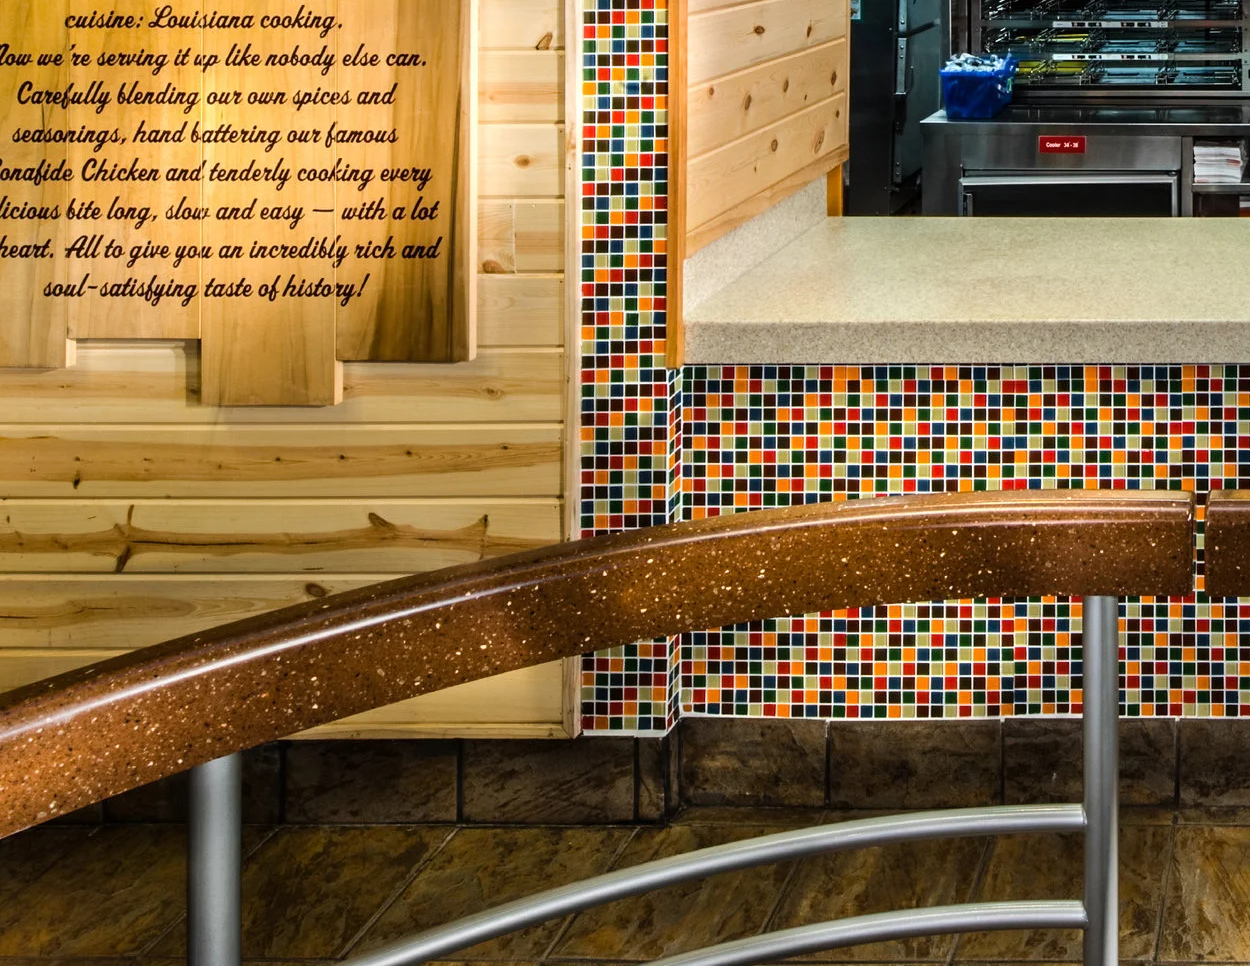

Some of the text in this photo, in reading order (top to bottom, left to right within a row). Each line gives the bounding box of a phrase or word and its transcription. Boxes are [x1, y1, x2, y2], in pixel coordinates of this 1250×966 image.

[65, 5, 342, 38] cuisine: Louisiana cooking.
[37, 44, 91, 66] we're
[97, 49, 168, 75] serving
[174, 48, 191, 66] it
[194, 55, 218, 73] up
[226, 44, 261, 66] like
[265, 46, 335, 75] nobody
[343, 44, 380, 66] else
[386, 54, 426, 66] can.
[17, 81, 398, 115] Carefully blending our own spices and
[12, 121, 398, 152] seasonings, hand battering our famous
[0, 158, 432, 191] onafide Chicken and tenderly cooking every
[66, 198, 100, 219] bite
[107, 196, 157, 229] long,
[166, 197, 208, 219] slow
[216, 199, 257, 219] and
[261, 206, 303, 229] easy
[342, 198, 387, 220] with
[392, 207, 406, 220] a
[411, 196, 439, 220] lot
[0, 235, 442, 268] heart. All to give you an incredibly rich and
[44, 273, 370, 307] soul-satisfying taste of history!
